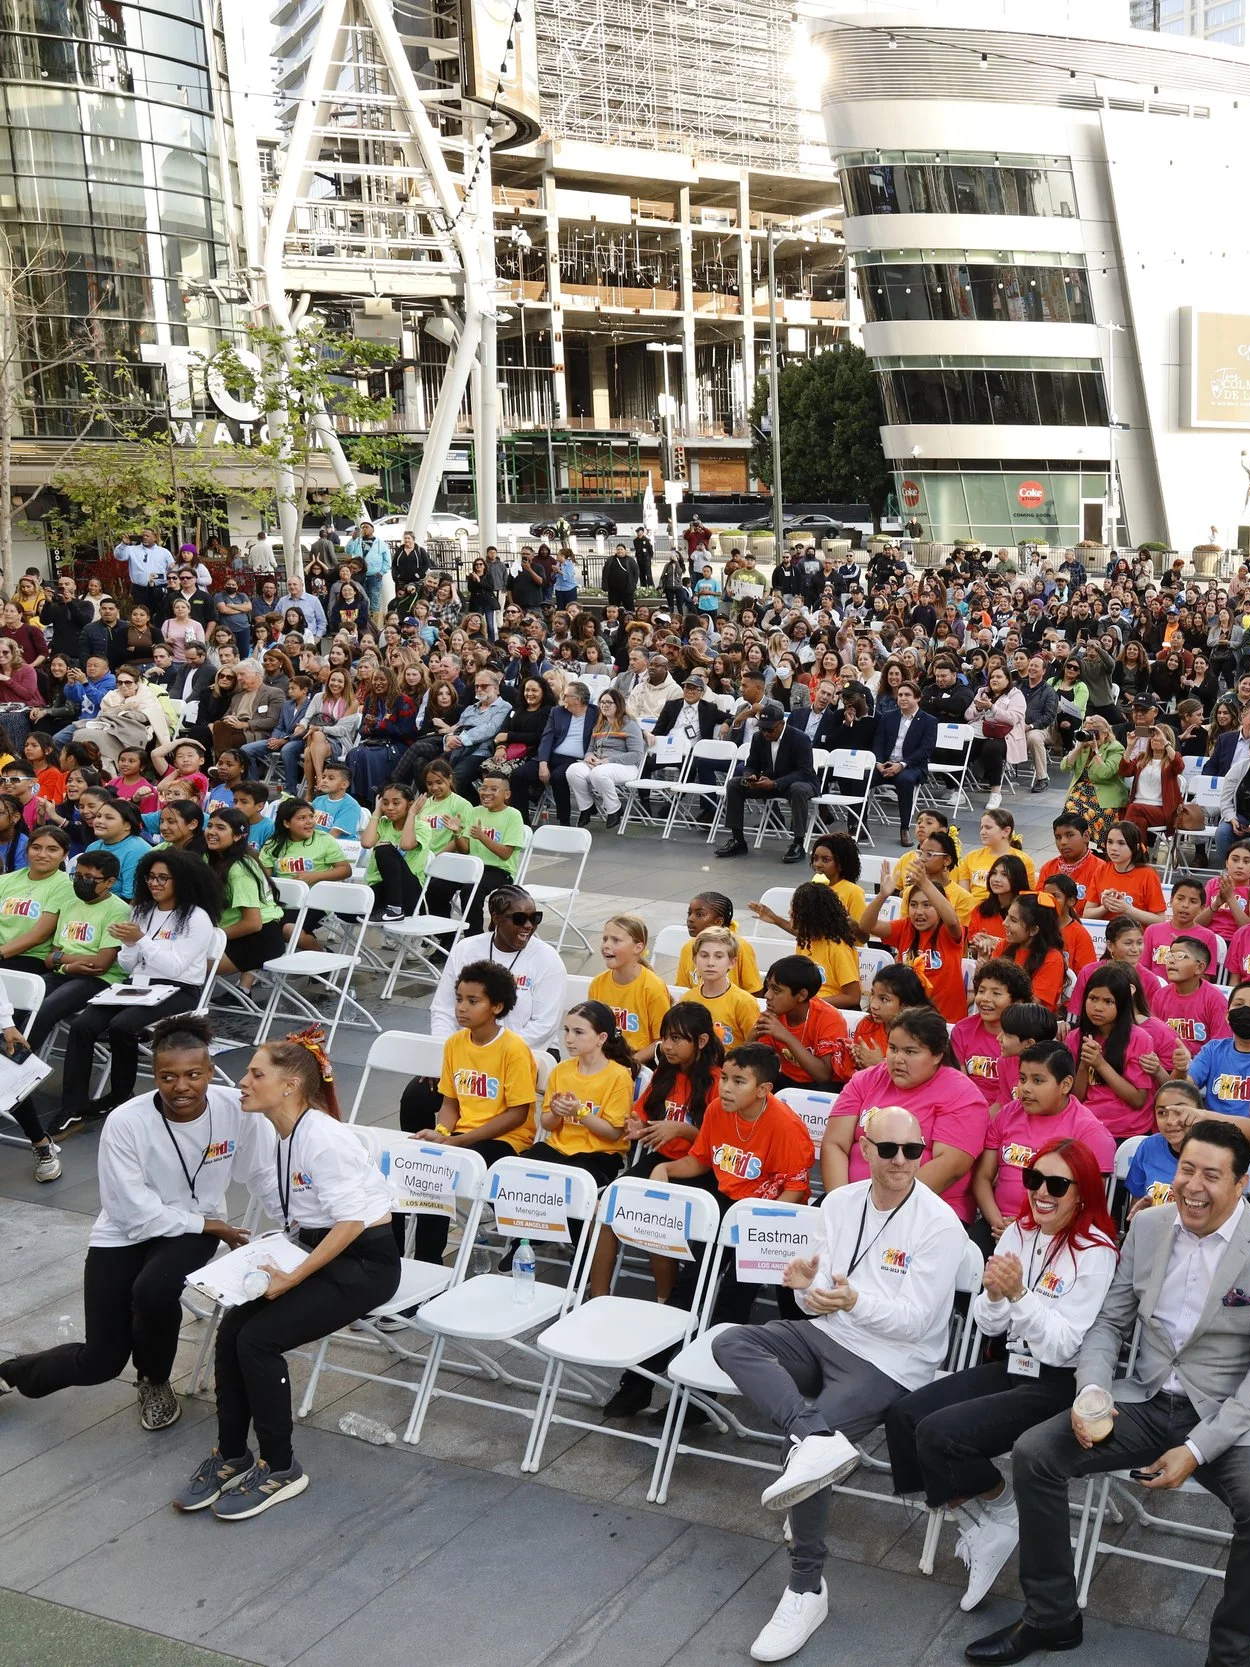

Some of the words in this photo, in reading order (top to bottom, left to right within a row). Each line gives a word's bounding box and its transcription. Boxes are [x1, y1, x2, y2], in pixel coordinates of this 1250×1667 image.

[1224, 389, 1240, 400] DE
[1019, 487, 1043, 498] Coke
[458, 1069, 499, 1099] Kids
[394, 1157, 455, 1180] Community
[404, 1174, 443, 1194] Magnet
[497, 1187, 564, 1207] Annandale
[405, 1200, 417, 1208] LOS
[418, 1201, 444, 1210] ANGELES
[515, 1206, 547, 1217] Merengue
[615, 1206, 684, 1231] Annandale
[522, 1221, 549, 1230] ANGELES
[633, 1226, 667, 1239] Merengue
[747, 1228, 808, 1245] Eastman
[760, 1247, 796, 1257] Merengue
[757, 1262, 770, 1270] LOS
